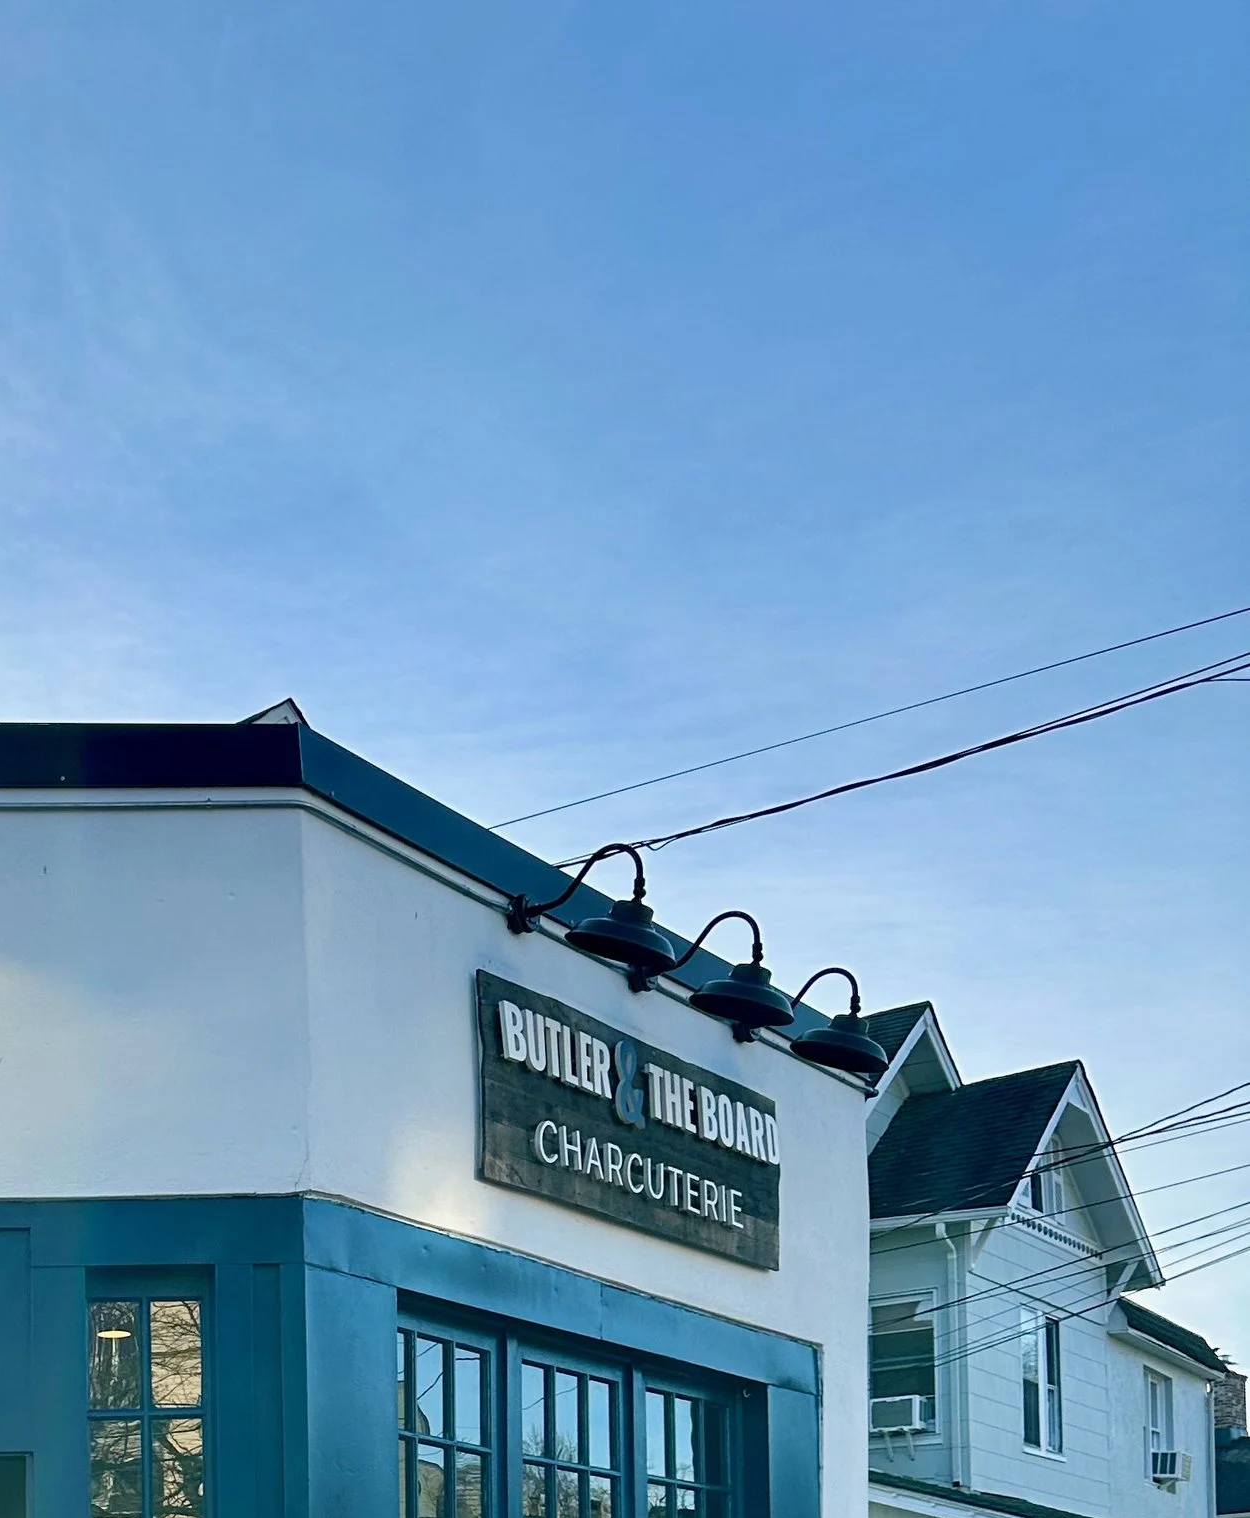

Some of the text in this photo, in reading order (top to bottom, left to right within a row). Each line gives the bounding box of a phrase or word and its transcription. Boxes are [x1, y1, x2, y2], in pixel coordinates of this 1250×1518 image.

[499, 1000, 780, 1165] BUTLER & THE BOARD
[535, 1120, 744, 1229] CHARCUTERIE
